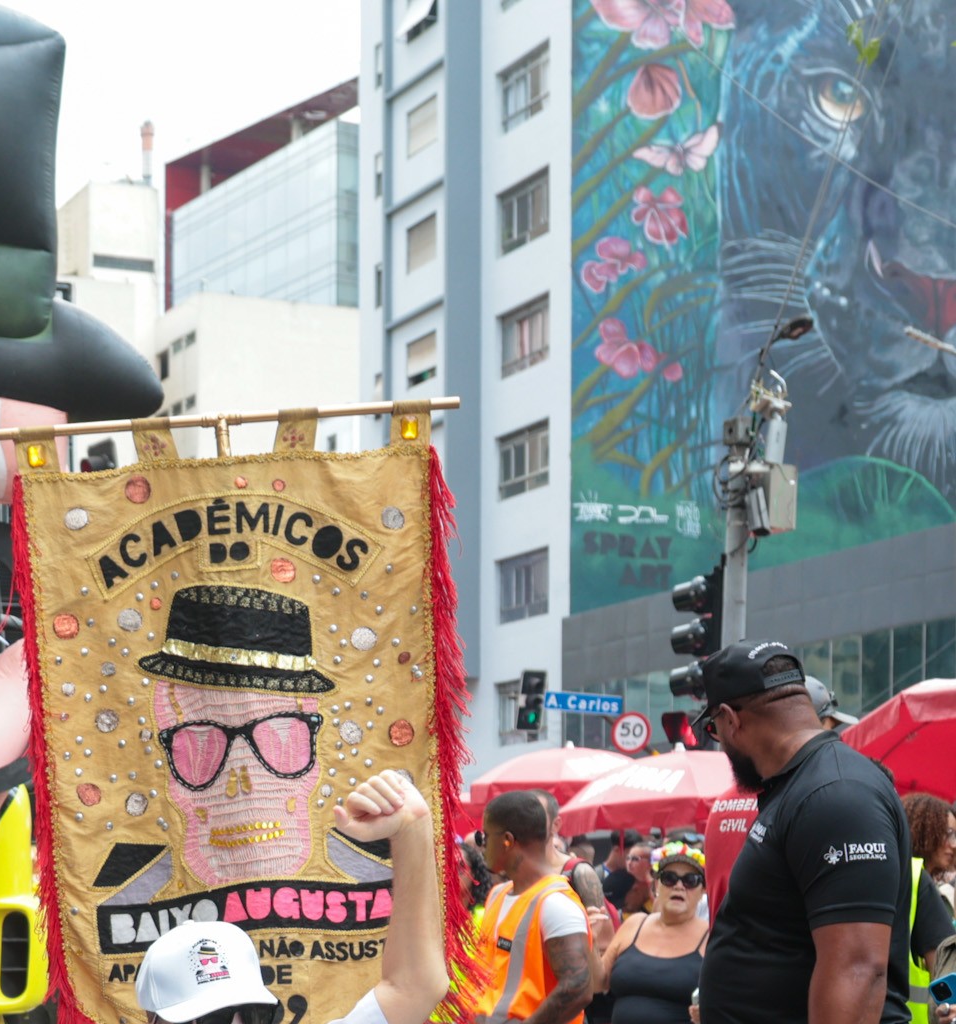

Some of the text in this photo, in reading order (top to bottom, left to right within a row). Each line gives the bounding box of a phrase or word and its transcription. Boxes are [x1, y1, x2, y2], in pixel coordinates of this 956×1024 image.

[98, 499, 369, 589] ACADÊMICOS
[209, 540, 250, 564] DO
[583, 530, 674, 560] SPRAY
[620, 562, 673, 590] ART
[547, 694, 619, 713] A. Carlos
[620, 722, 644, 738] 50
[719, 818, 748, 832] CIVIL
[849, 843, 887, 855] FAQUI
[849, 853, 887, 861] SEGURANÇA
[110, 886, 392, 945] BAIXO AUGUSTA
[259, 936, 305, 958] NÃO
